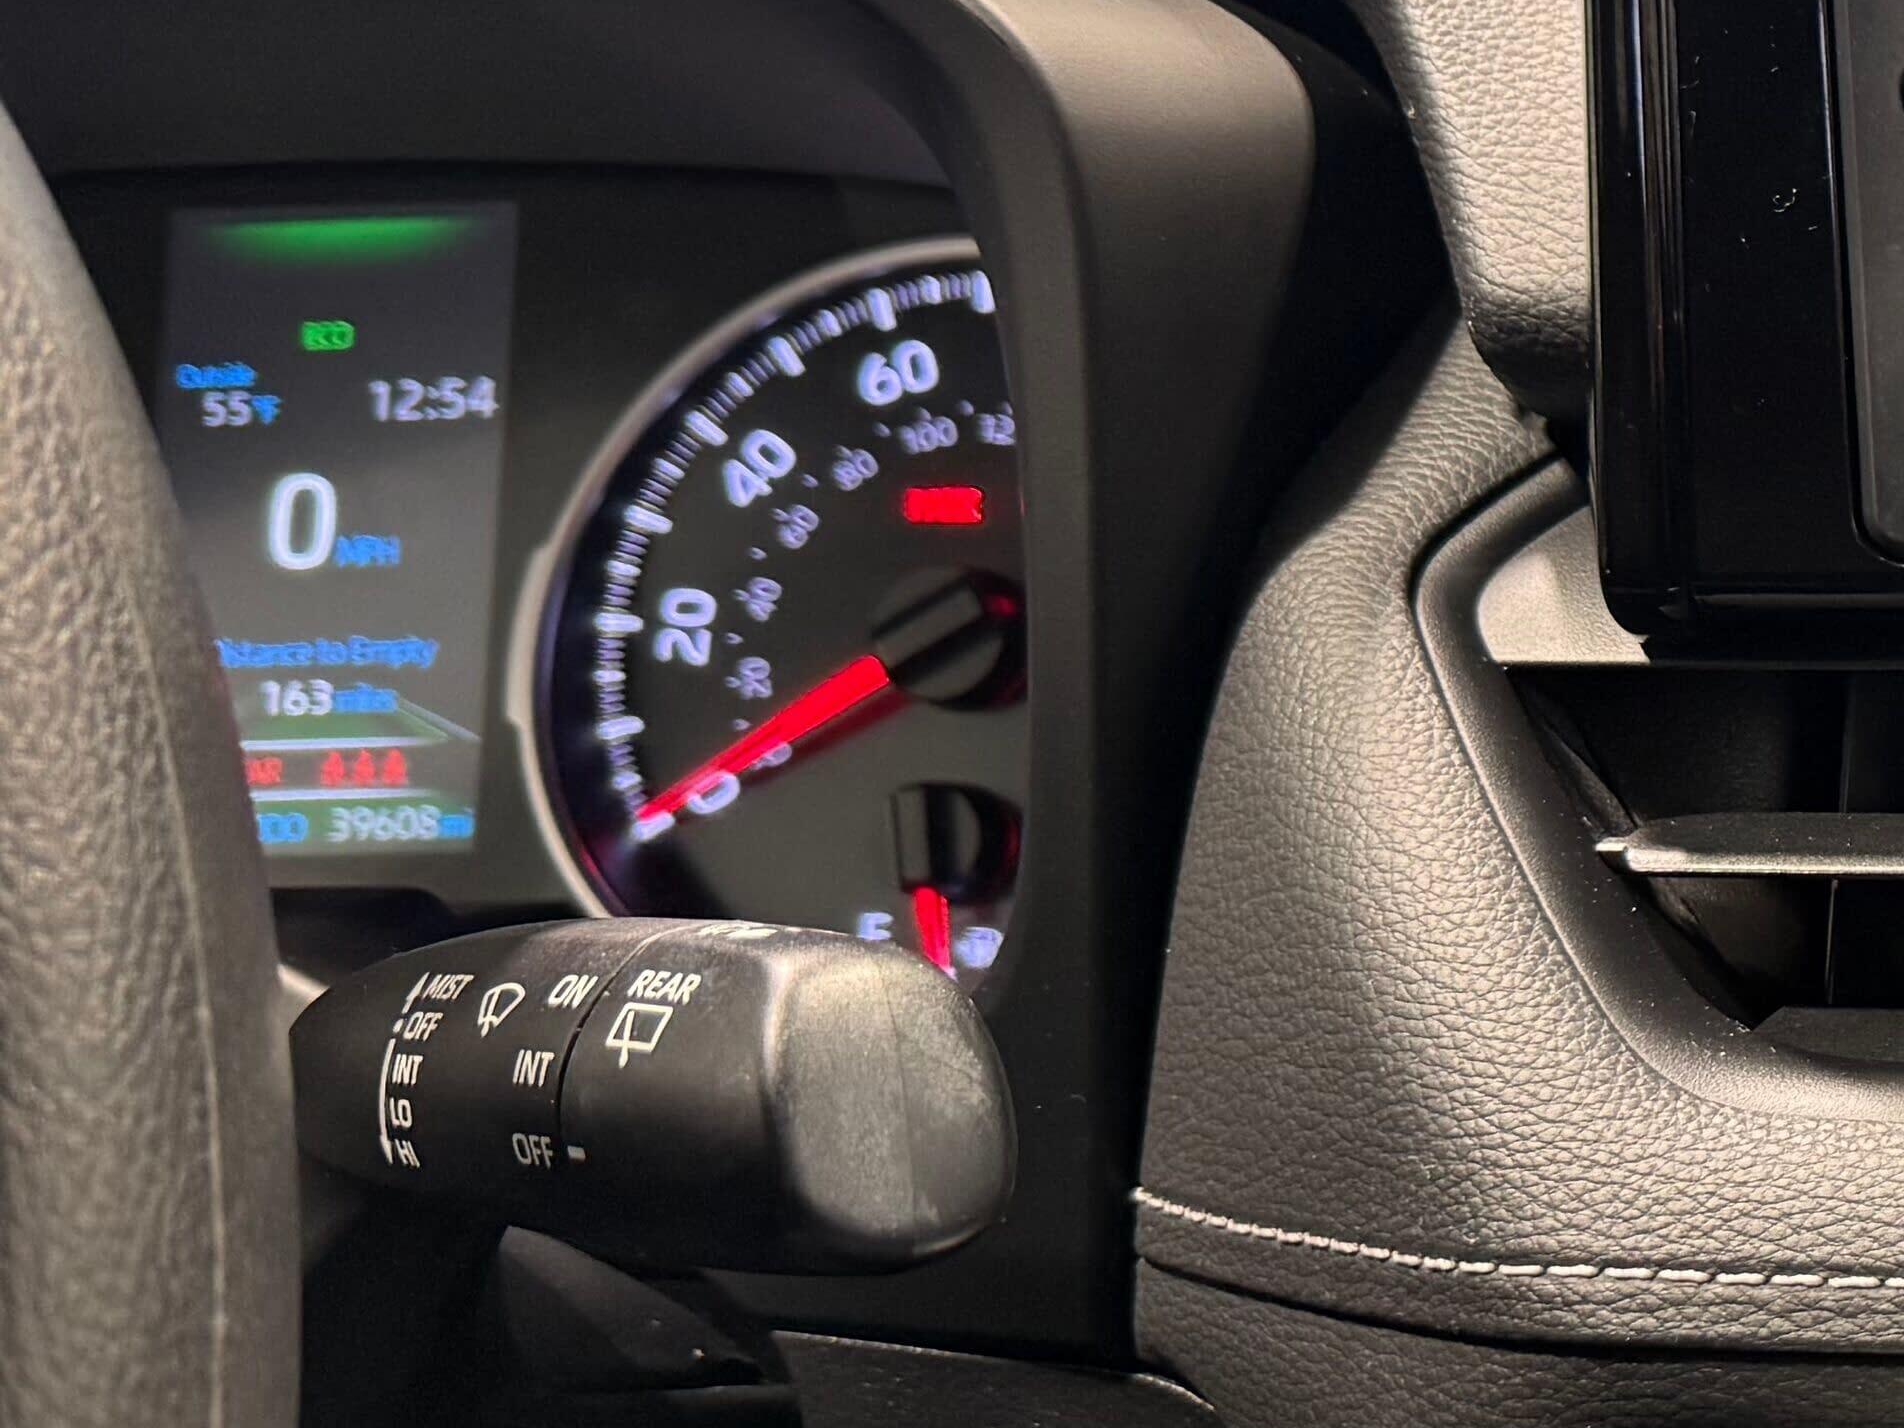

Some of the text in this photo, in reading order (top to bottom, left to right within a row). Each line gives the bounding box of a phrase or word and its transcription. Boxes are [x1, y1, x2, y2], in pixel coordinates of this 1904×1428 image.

[855, 338, 942, 407] 60
[367, 375, 499, 422] 12:54
[721, 428, 798, 509] 40
[267, 471, 338, 571] 0
[652, 586, 719, 667] 20
[259, 677, 335, 717] 163
[421, 973, 475, 1001] MIST
[546, 974, 600, 1010] ON
[626, 967, 702, 1006] REAR
[402, 1010, 445, 1042] OFF
[390, 1053, 424, 1086] INT
[511, 1048, 556, 1088] INT
[388, 1097, 413, 1129] LO
[393, 1138, 421, 1169] HI
[511, 1132, 554, 1170] OFF
